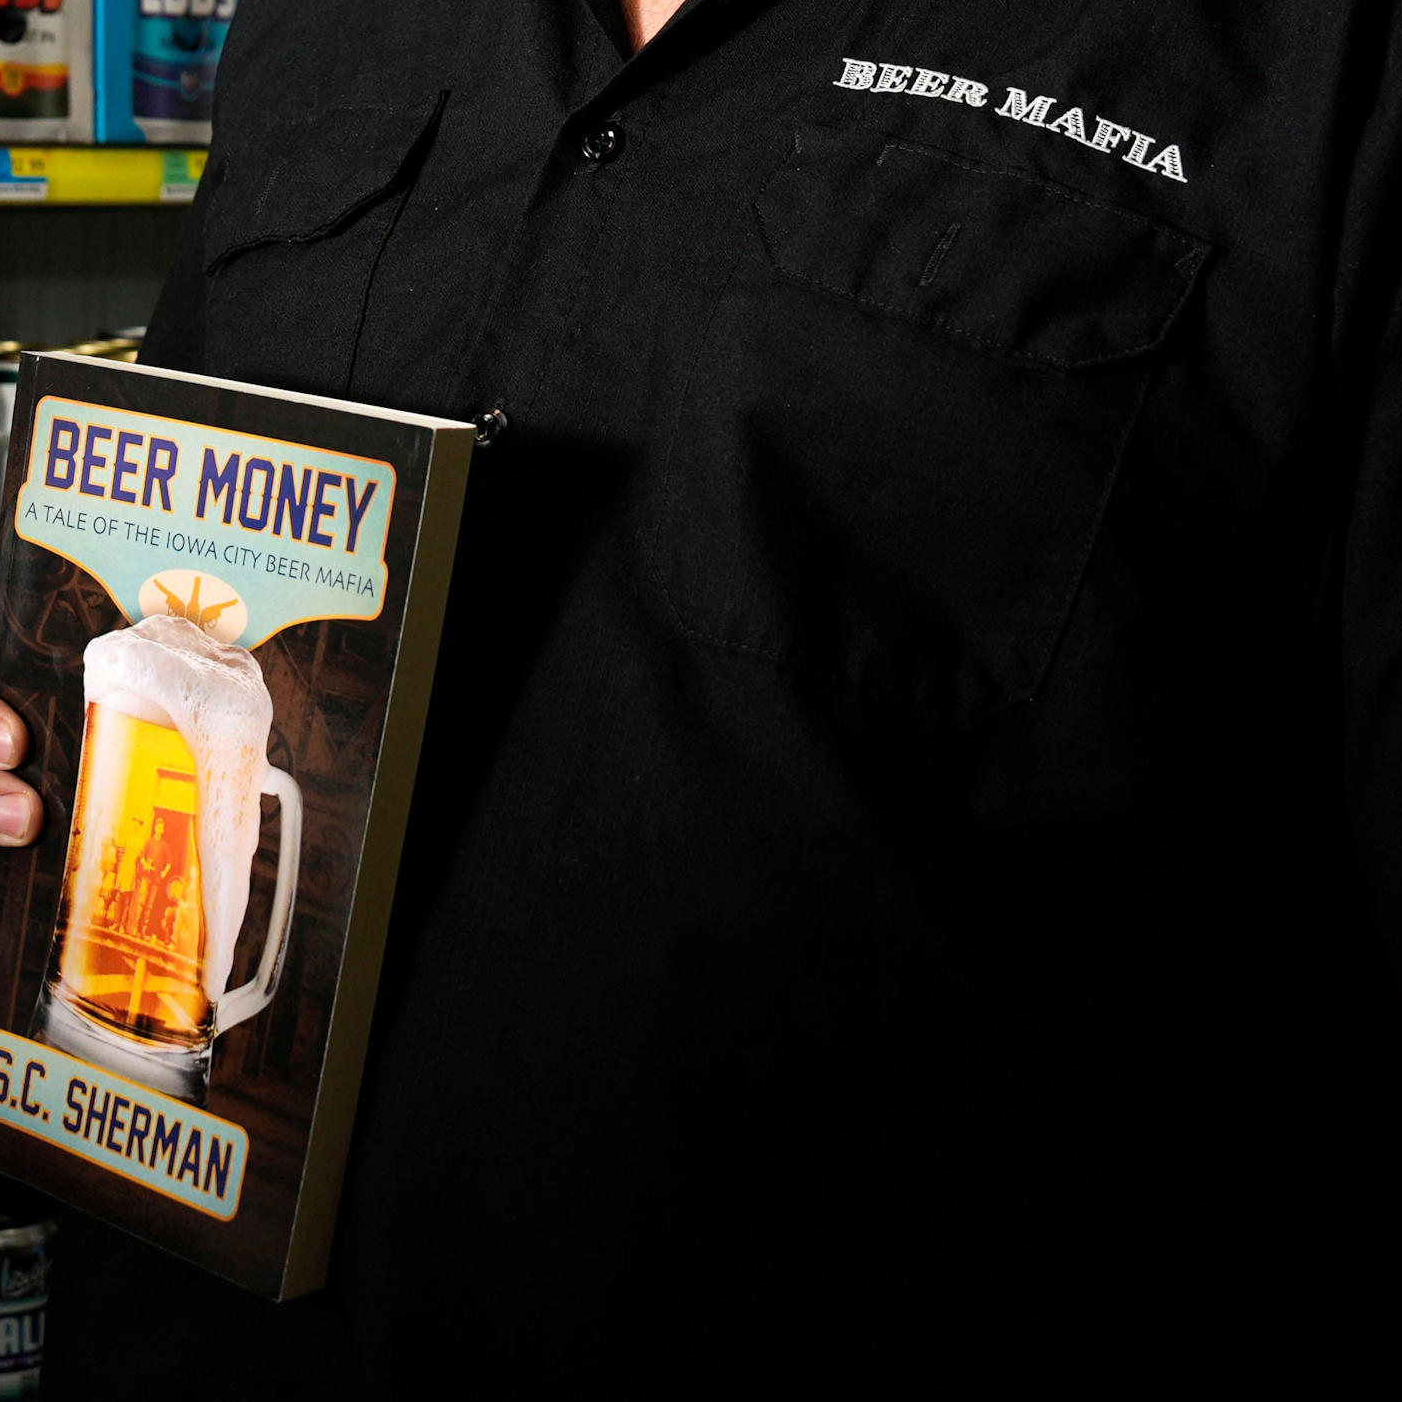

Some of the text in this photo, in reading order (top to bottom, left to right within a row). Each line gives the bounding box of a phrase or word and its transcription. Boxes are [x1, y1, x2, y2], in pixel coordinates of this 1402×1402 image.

[833, 58, 1188, 183] BEER MAFIA
[43, 416, 380, 555] BEER MONEY
[25, 502, 375, 598] A TALE OF THE IOWA CITY BEER MAFIA
[62, 1079, 235, 1200] SHERMAN
